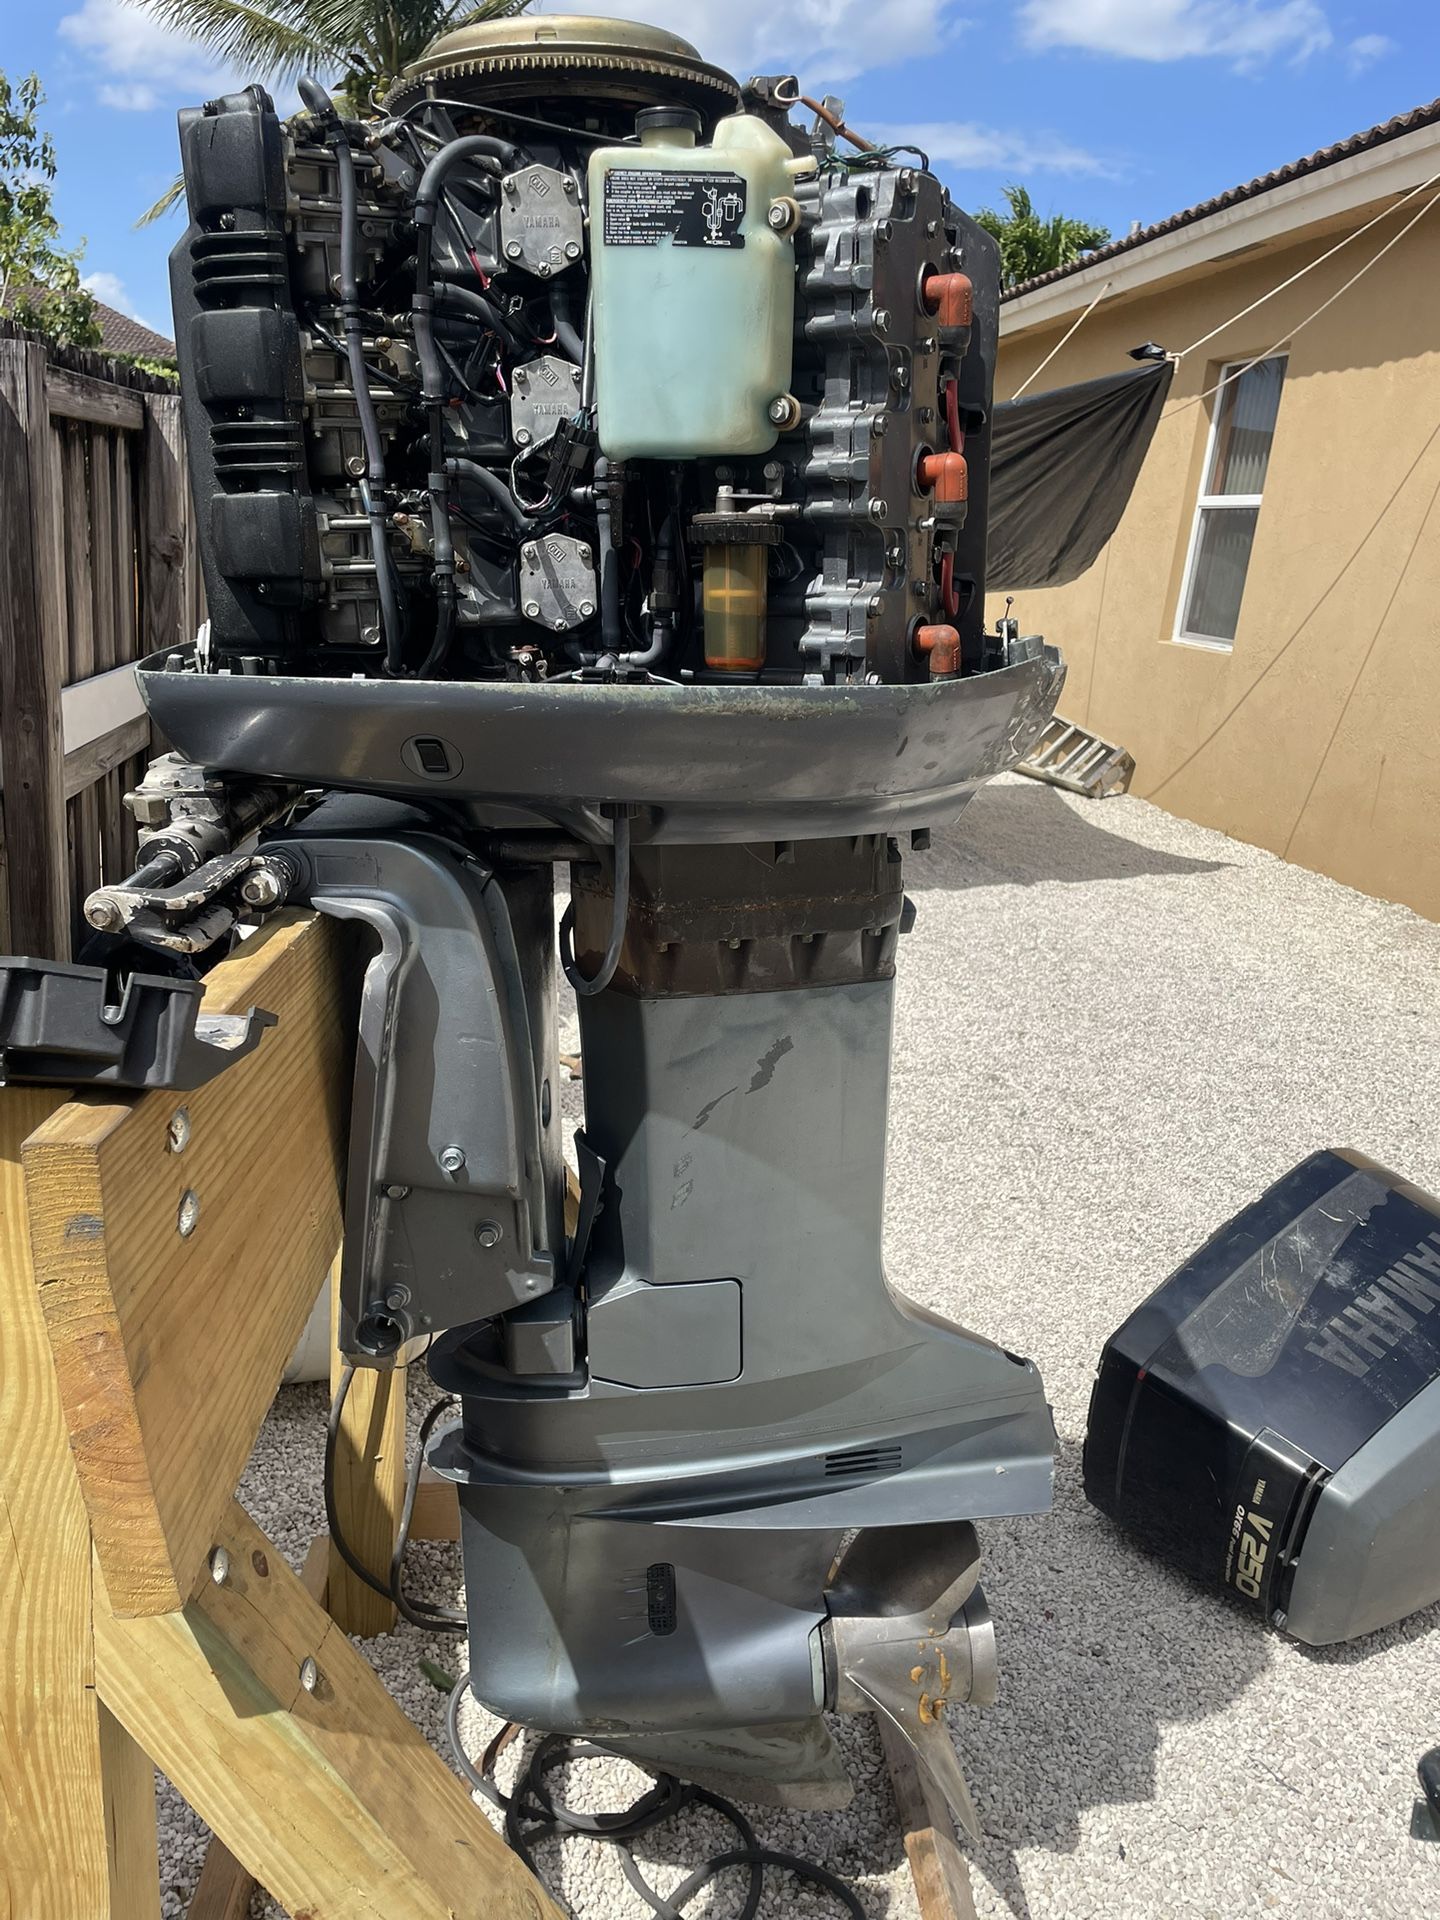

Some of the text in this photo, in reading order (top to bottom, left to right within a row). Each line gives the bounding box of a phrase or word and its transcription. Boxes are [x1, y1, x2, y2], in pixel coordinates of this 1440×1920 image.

[523, 214, 561, 229] YAMAHA
[532, 403, 569, 416] YAMAHA
[541, 577, 576, 590] YAMAHA
[1304, 1231, 1440, 1378] AMAHA
[1252, 1479, 1267, 1505] YAMAHA
